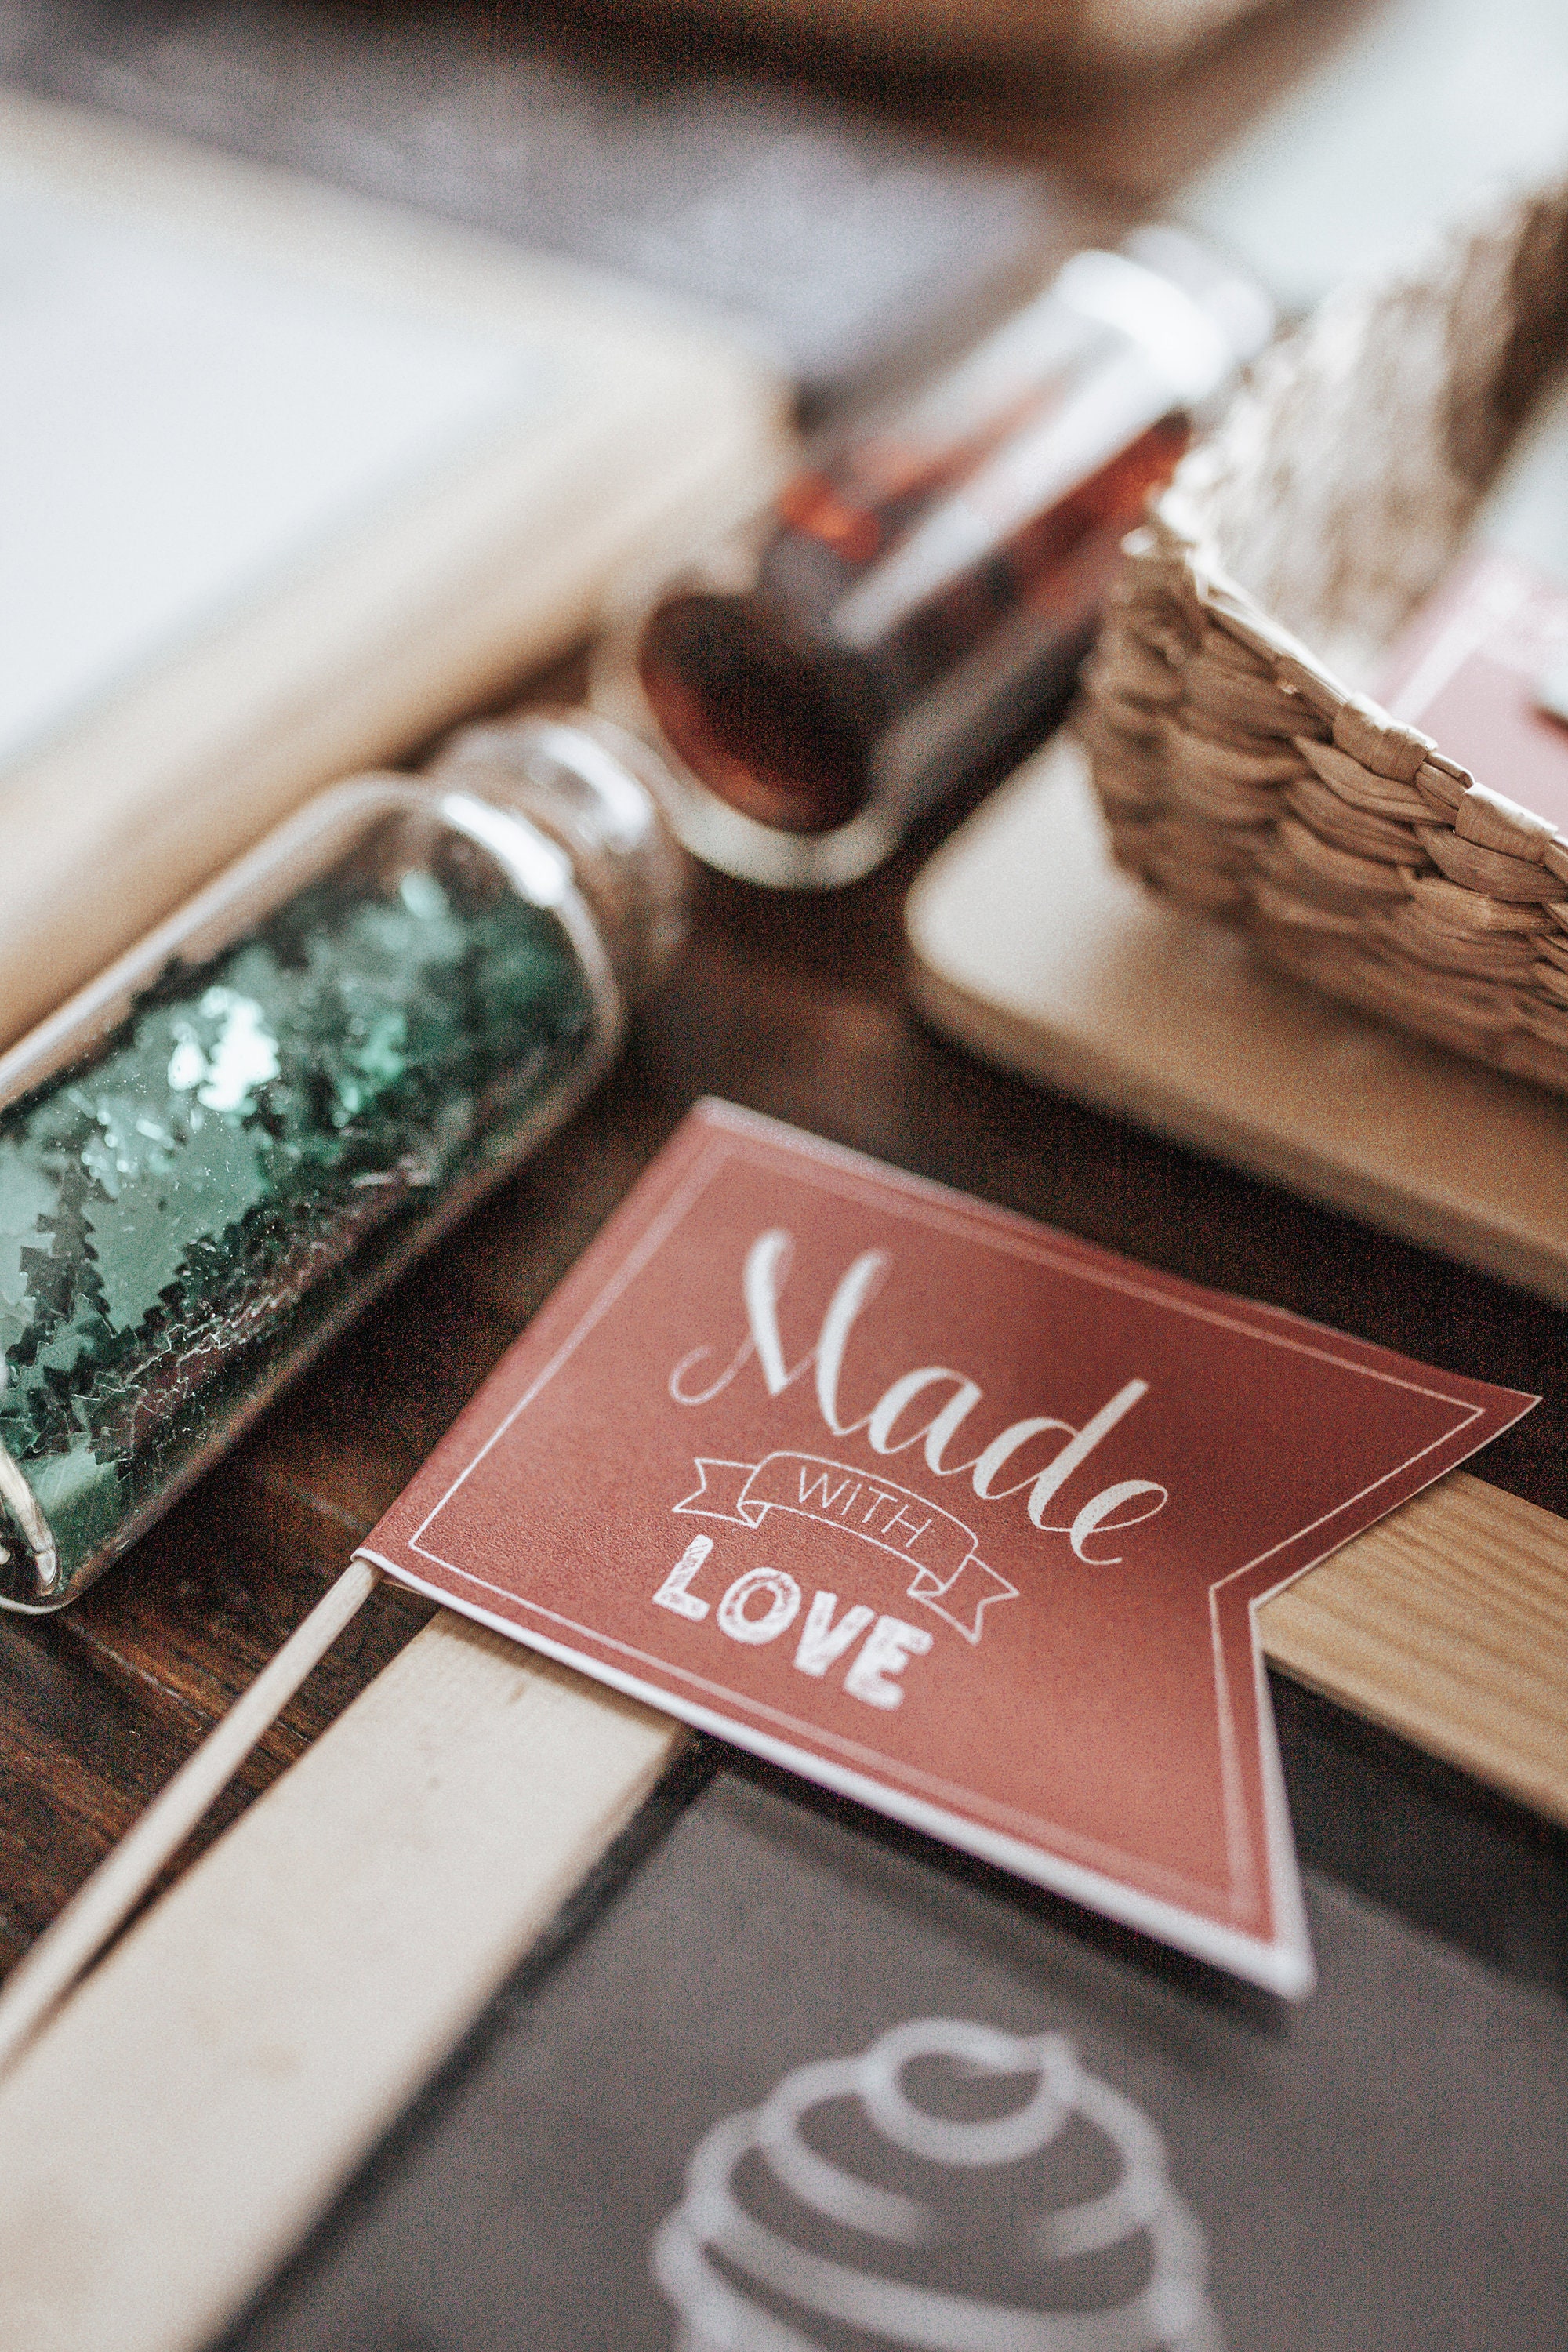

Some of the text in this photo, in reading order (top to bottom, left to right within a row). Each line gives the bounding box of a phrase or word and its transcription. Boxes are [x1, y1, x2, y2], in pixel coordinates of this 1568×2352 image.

[669, 1228, 1168, 1566] Made
[798, 1466, 932, 1547] WITH
[652, 1534, 934, 1710] LOVE
